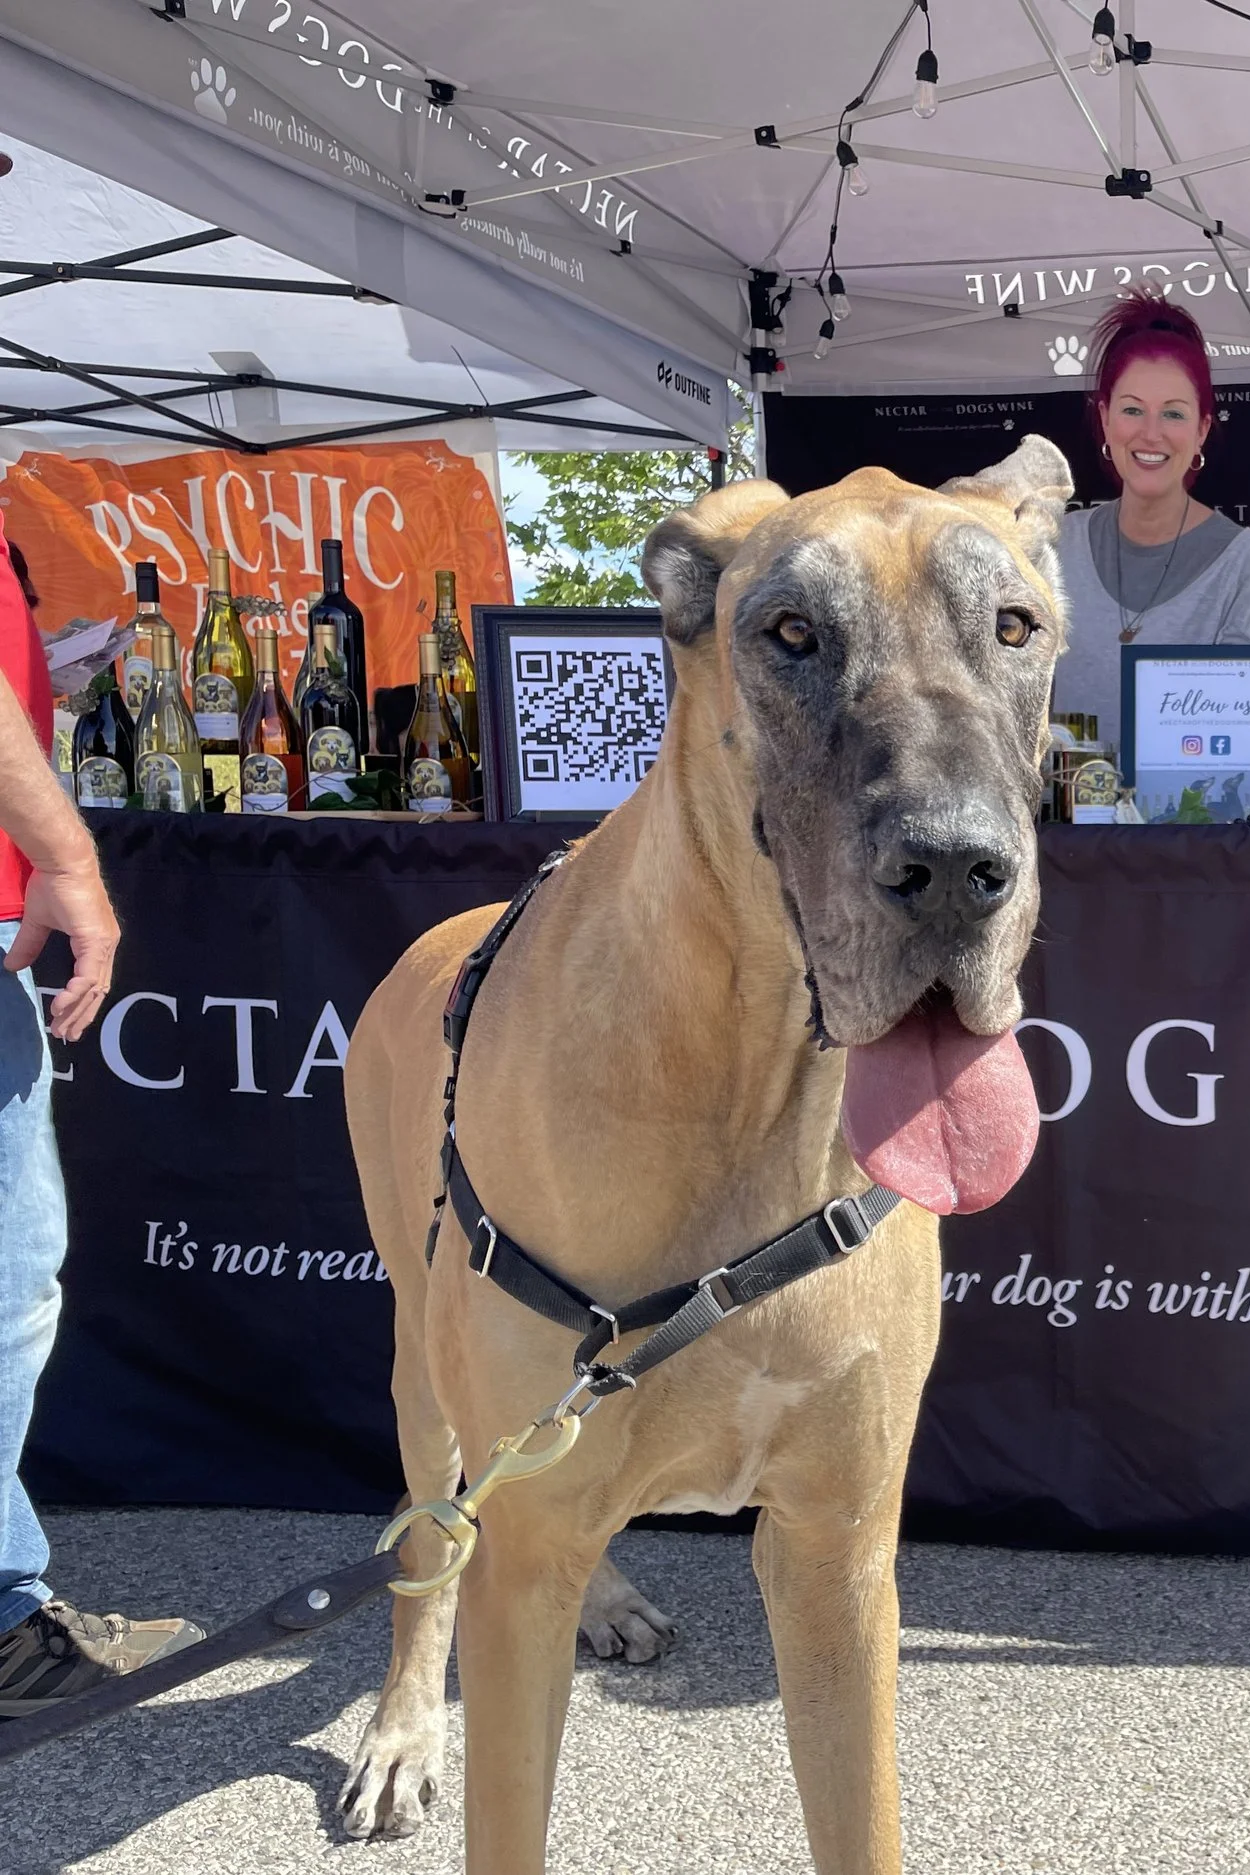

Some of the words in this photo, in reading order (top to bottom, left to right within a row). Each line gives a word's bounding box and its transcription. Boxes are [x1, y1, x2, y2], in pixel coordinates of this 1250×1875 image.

[674, 372, 711, 406] OUTFINE
[874, 405, 928, 417] NECTAR
[956, 403, 995, 415] DOGS
[997, 401, 1035, 412] WINE
[85, 470, 406, 595] PSYCHIC
[1159, 689, 1229, 716] Follow
[143, 1220, 199, 1271] It's
[211, 1241, 291, 1278] not
[991, 1253, 1084, 1328] dog
[1093, 1264, 1133, 1312] is
